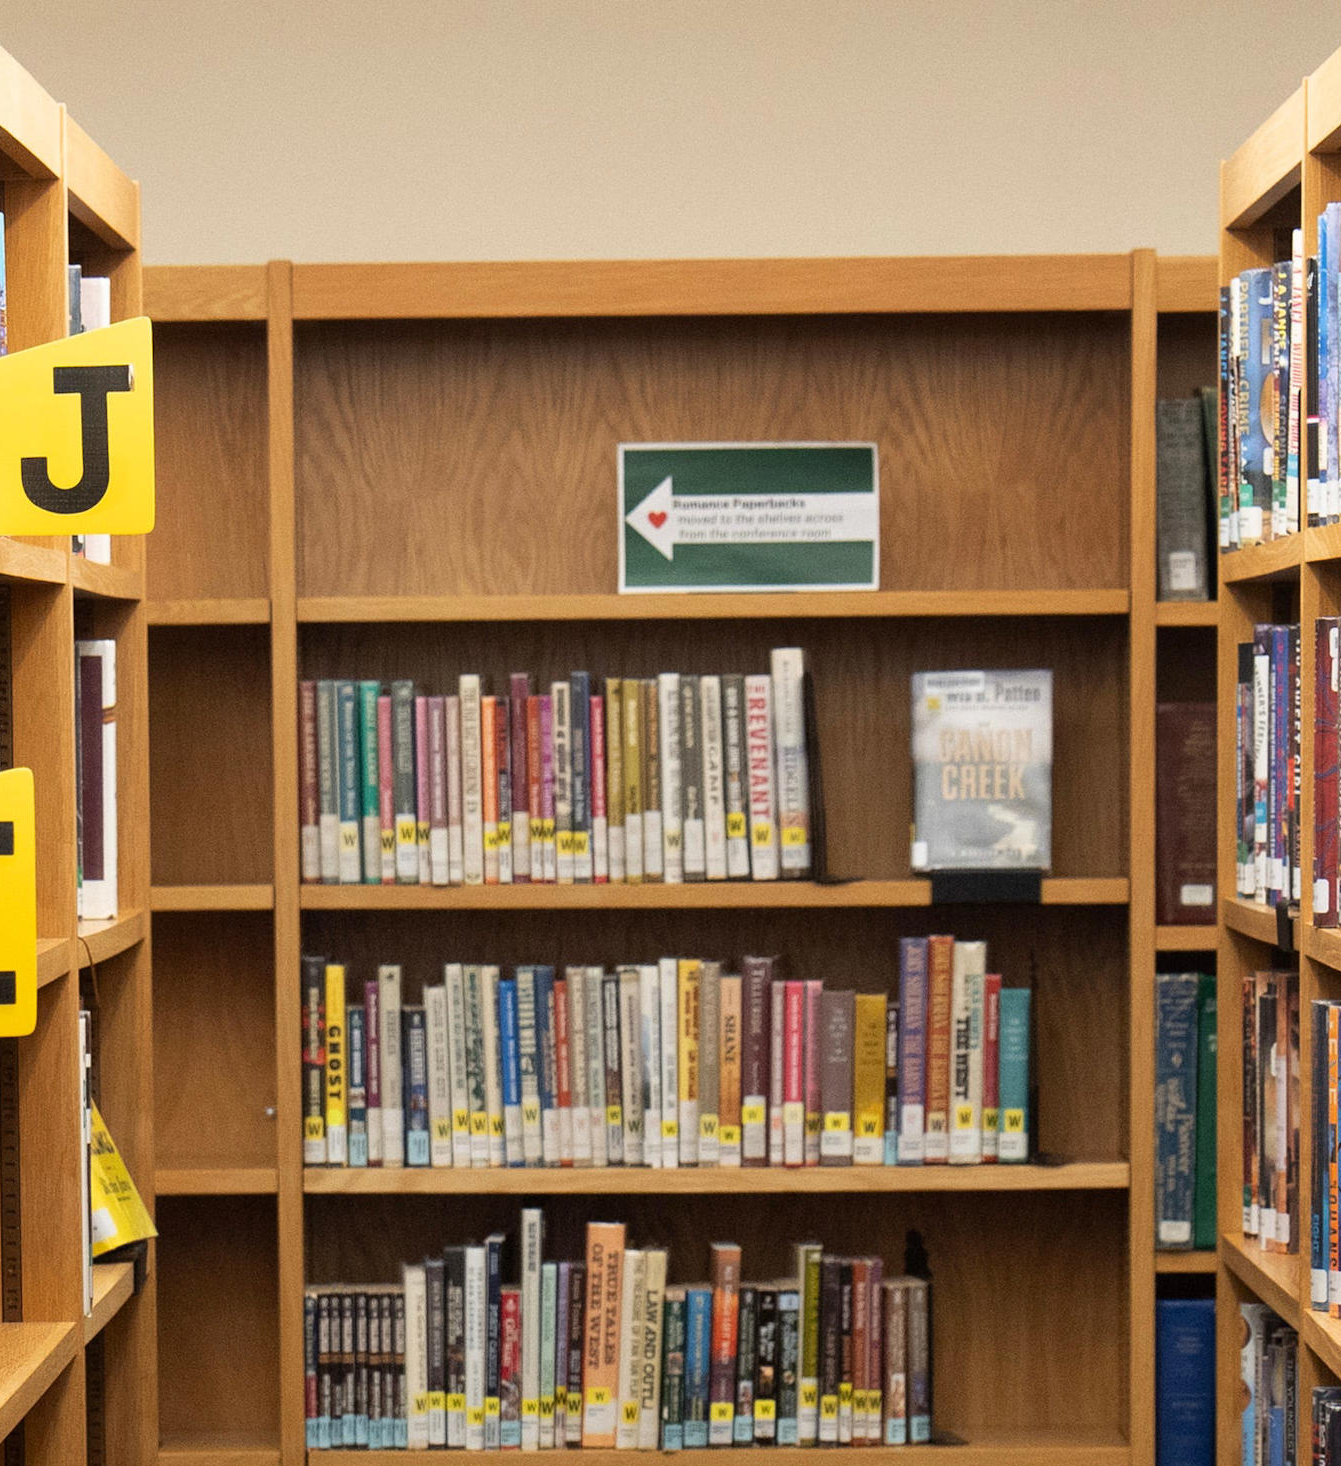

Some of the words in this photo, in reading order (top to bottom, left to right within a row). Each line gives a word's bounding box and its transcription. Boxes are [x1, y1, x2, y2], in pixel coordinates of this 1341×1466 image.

[1238, 281, 1251, 361] PARTNER
[1278, 302, 1287, 352] JANCE
[1238, 379, 1250, 436] CRIME
[21, 365, 130, 514] J
[673, 498, 730, 510] Romance
[733, 497, 806, 511] Paperbacks
[748, 697, 770, 819] REVENANT
[942, 764, 1025, 800] CREEK
[344, 833, 356, 846] W
[382, 835, 394, 848] W
[402, 827, 413, 838] W
[724, 1014, 736, 1064] SHANE
[328, 1025, 342, 1101] GHOST
[955, 1053, 970, 1100] WEST
[526, 1109, 537, 1120] W
[704, 1121, 716, 1133] W
[592, 1242, 604, 1268] OF
[591, 1271, 603, 1309] THE
[607, 1251, 619, 1302] TRUE
[645, 1289, 659, 1323] LAW
[589, 1313, 602, 1369] WEST
[605, 1304, 617, 1365] TALES
[644, 1325, 657, 1360] AND
[1286, 1359, 1294, 1381] THE
[625, 1406, 637, 1419] W
[1286, 1386, 1294, 1455] YOUNGEST
